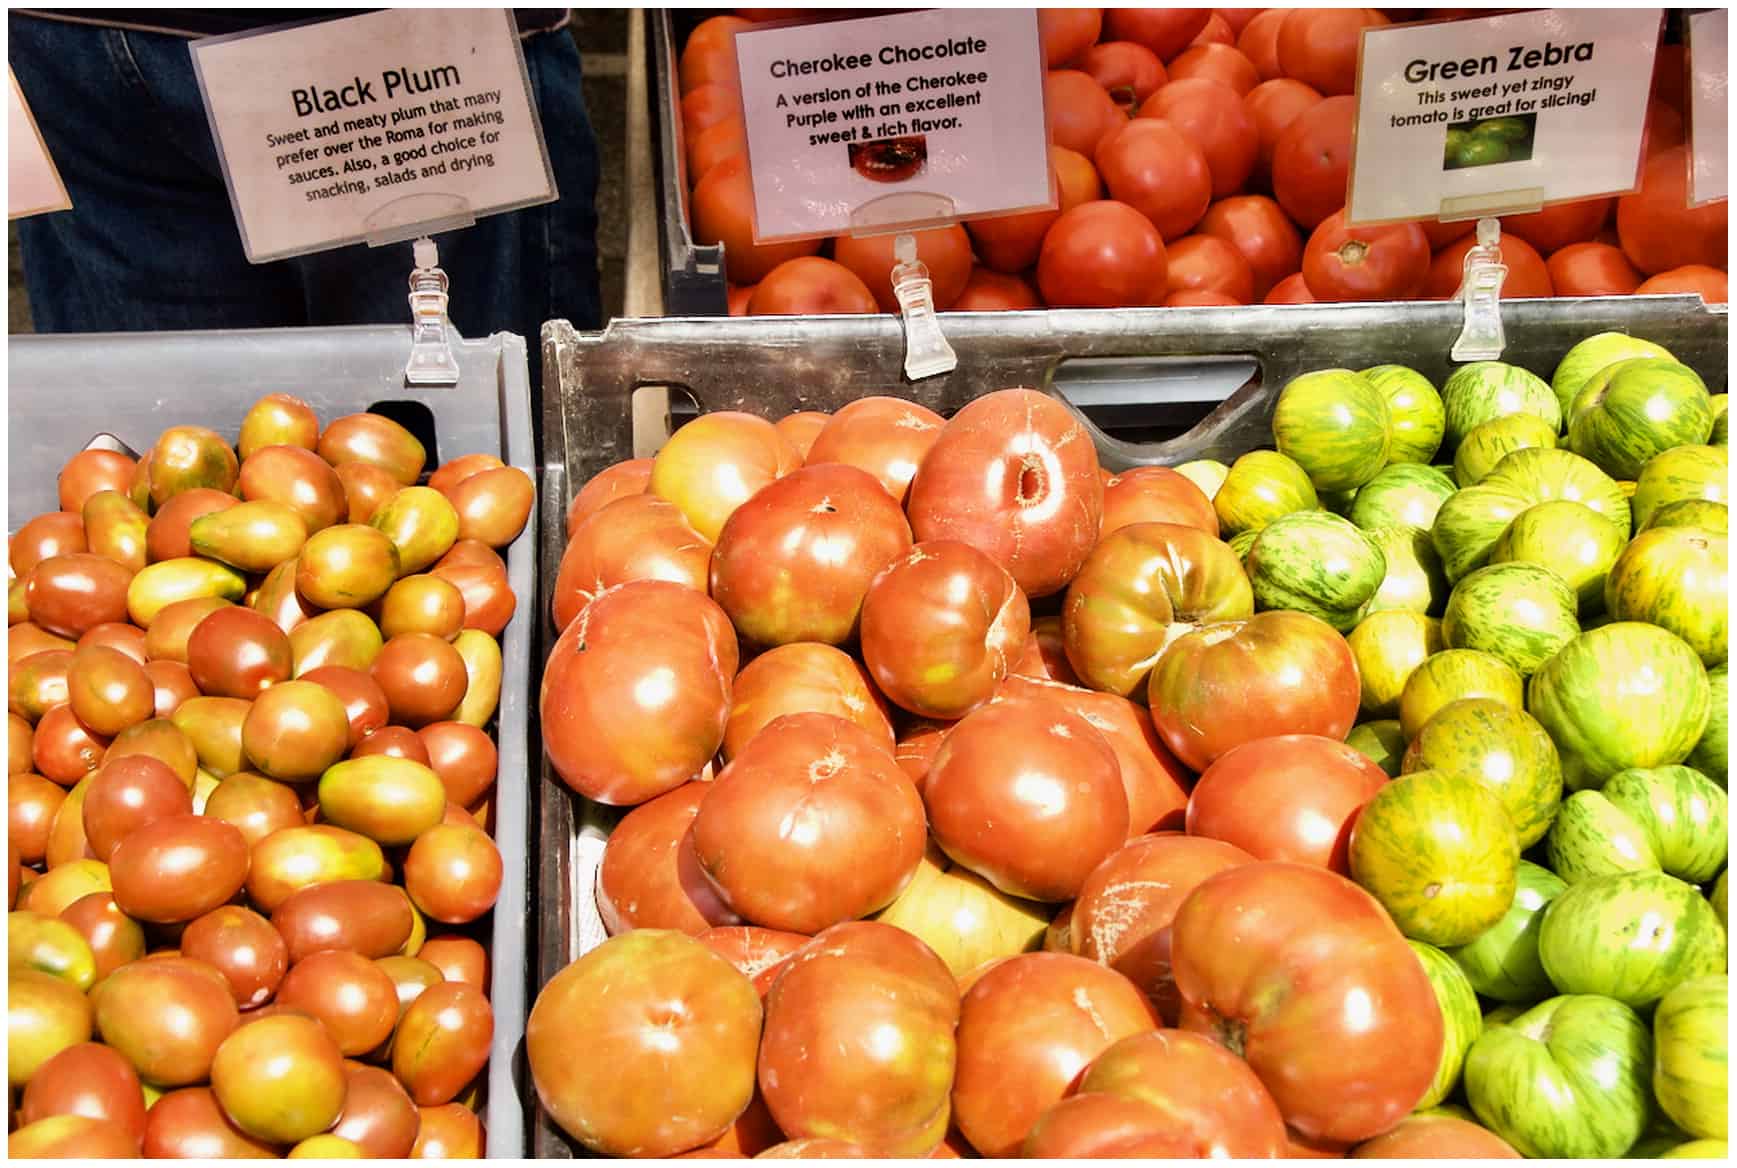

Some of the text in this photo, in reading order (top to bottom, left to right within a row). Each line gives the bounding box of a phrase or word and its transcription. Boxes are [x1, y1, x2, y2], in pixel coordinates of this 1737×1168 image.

[770, 37, 987, 78] Cherokee Chocolate
[1404, 41, 1595, 83] Green Zebra
[292, 64, 461, 118] Black Plum
[776, 70, 988, 108] A version of the Cherokee
[1390, 89, 1596, 127] tomato is great for slicing!
[1417, 74, 1574, 105] This sweet yet zingy
[266, 89, 502, 148] Sweet and meaty plum that many
[786, 92, 982, 128] Purple with an excellent
[276, 110, 504, 169] prefer over the Roma for making
[809, 116, 962, 146] sweet & rich flavor.
[288, 129, 501, 184] sauces. Also, a good choice for
[306, 152, 494, 202] snacking, salads and drying
